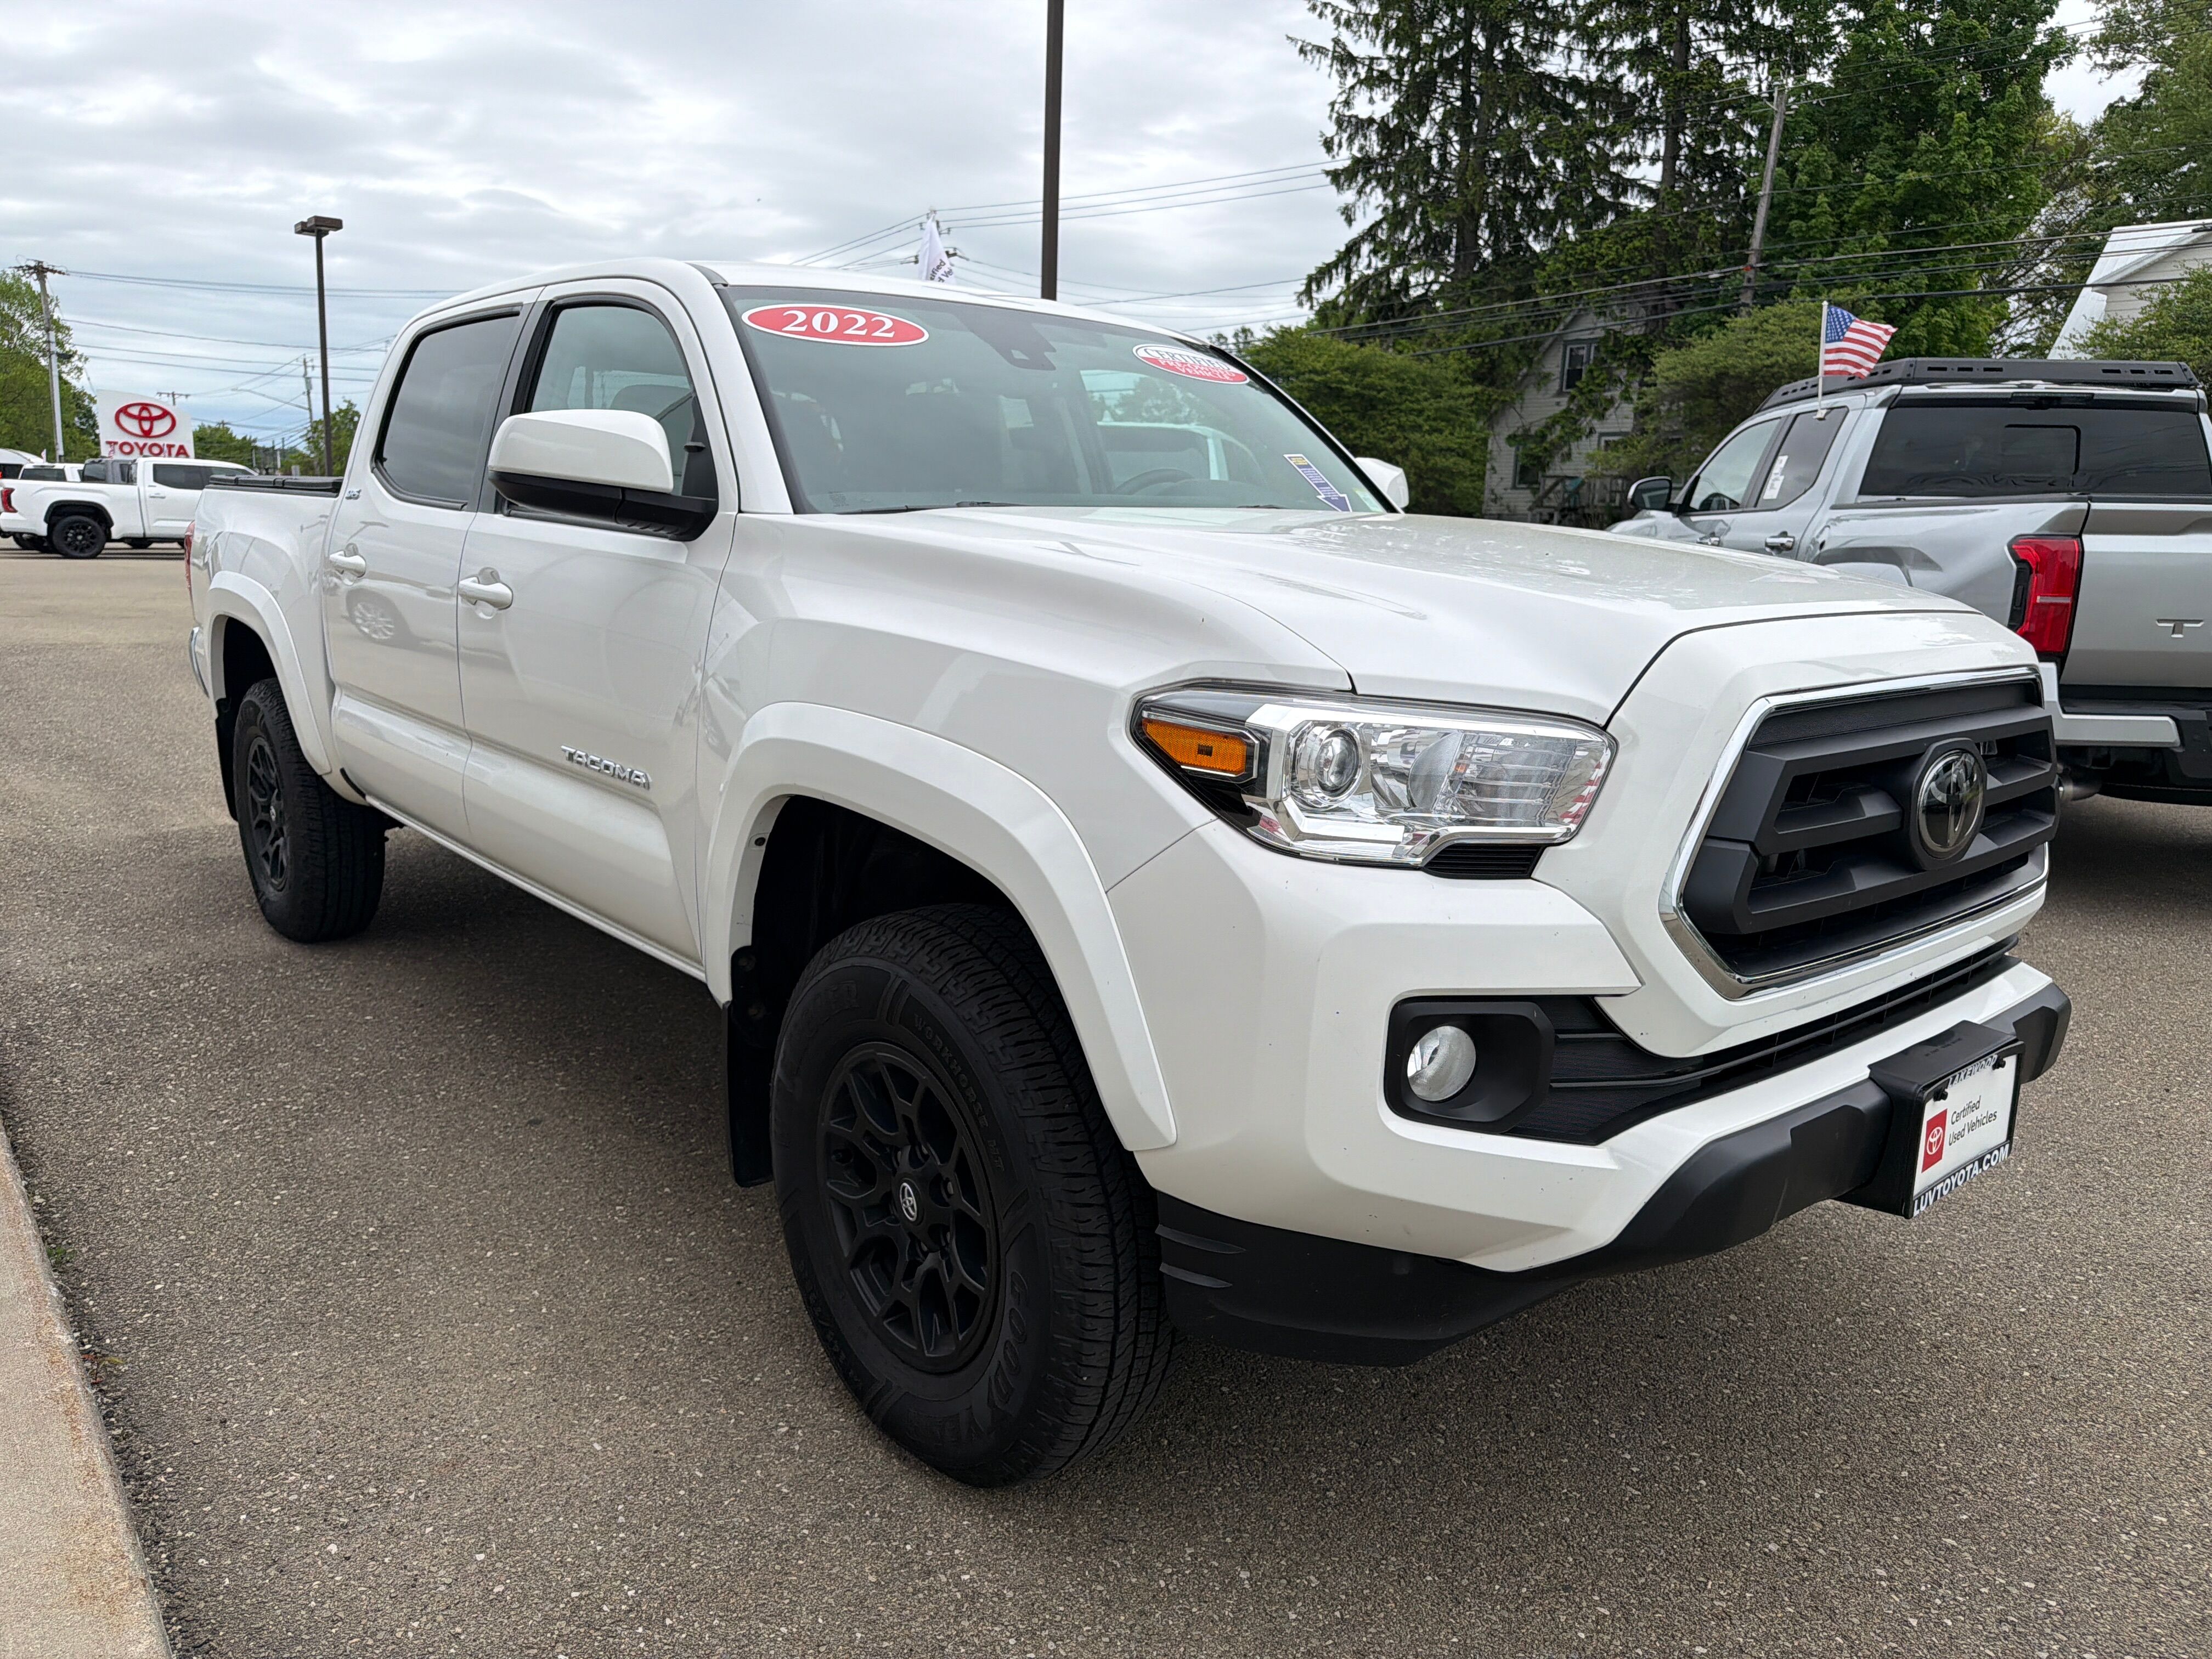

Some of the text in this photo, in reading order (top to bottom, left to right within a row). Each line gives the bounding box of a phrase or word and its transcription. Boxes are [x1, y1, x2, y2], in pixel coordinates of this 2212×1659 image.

[782, 310, 895, 338] 2022
[1144, 348, 1231, 370] CERTIFIED
[1158, 359, 1235, 377] PRE-OWNED
[1176, 367, 1233, 381] VEHICLE
[106, 441, 190, 458] TOYOTA
[561, 745, 652, 790] TACOMA
[913, 1013, 989, 1128] WORKHORSE
[1948, 1054, 1998, 1088] LAKEWOOD
[1951, 1096, 1981, 1125] Certified
[1949, 1111, 1997, 1146] Used Vehicles
[1913, 1144, 2009, 1215] LUVTOYOTA.COM
